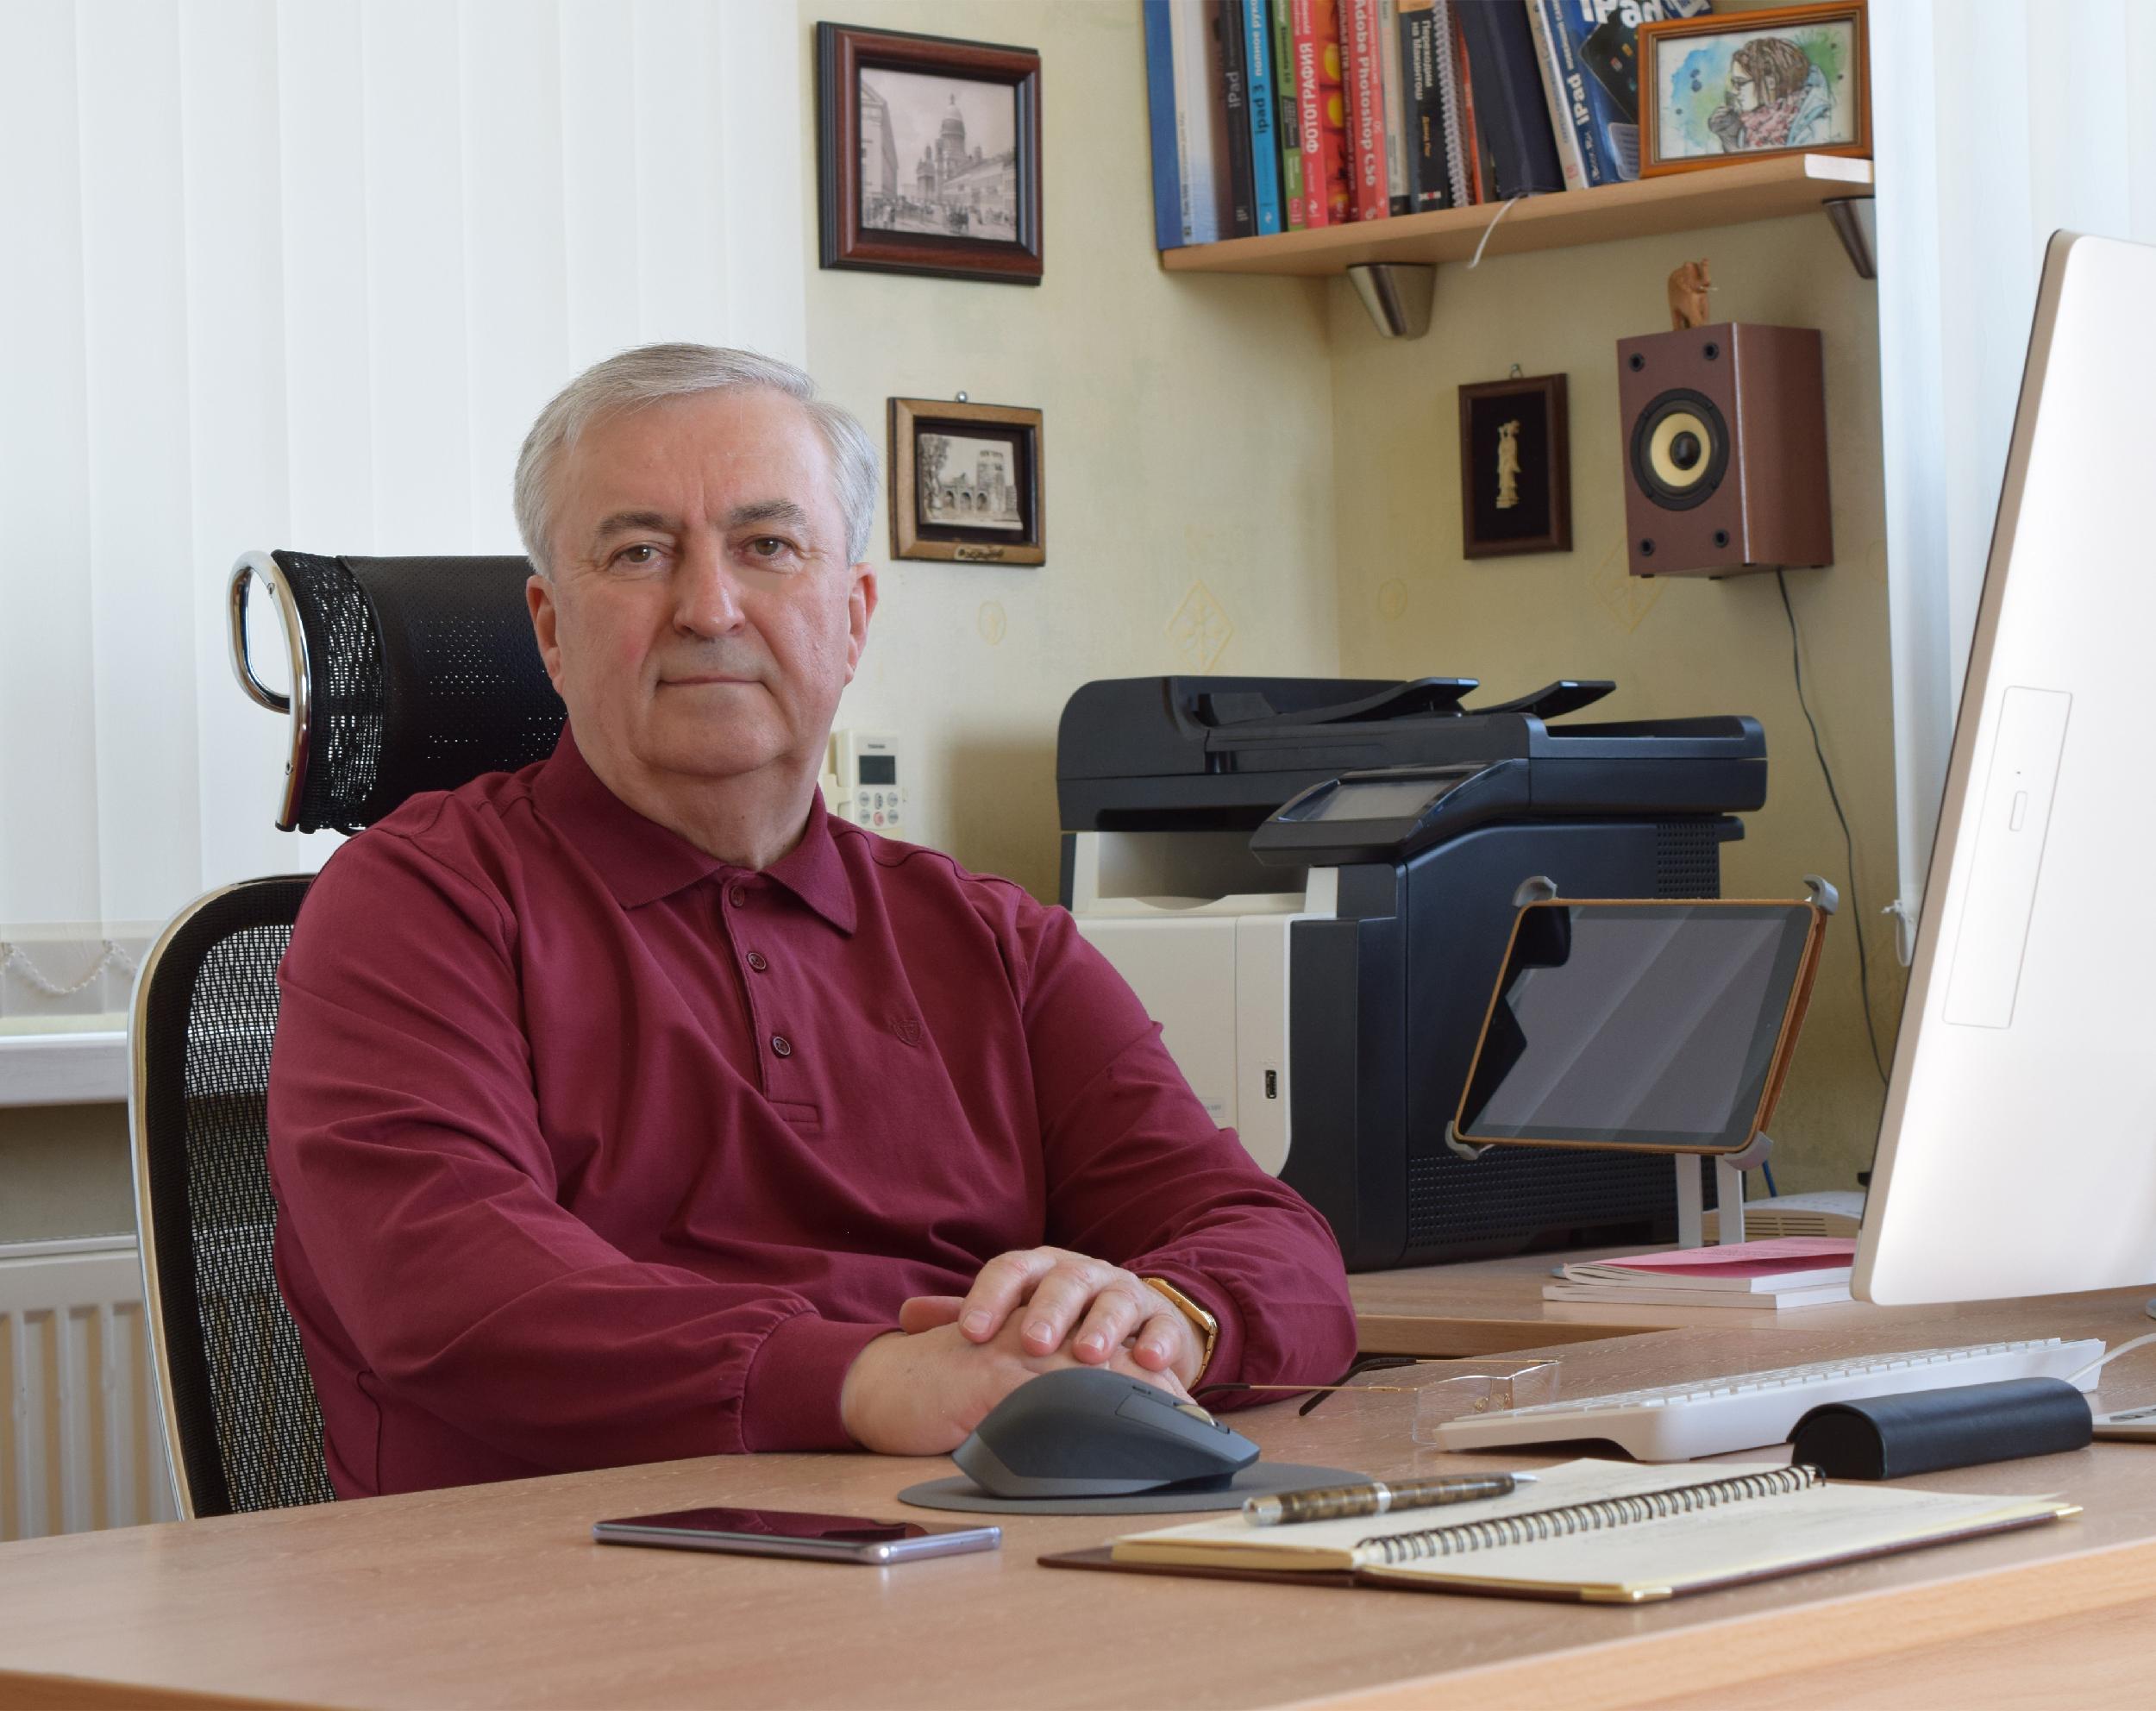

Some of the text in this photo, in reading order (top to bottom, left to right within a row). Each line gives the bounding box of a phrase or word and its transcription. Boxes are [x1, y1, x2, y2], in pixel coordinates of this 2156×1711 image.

[1355, 0, 1368, 53] Adobe
[1252, 30, 1263, 77] полное
[1412, 22, 1424, 100] на Макинтош
[1422, 21, 1432, 87] Переходим
[1225, 72, 1240, 108] iPad
[1253, 84, 1269, 134] ipad 3
[1300, 42, 1319, 154] ФОТОГРАФИЯ
[1357, 57, 1373, 150] Photoshop
[1567, 72, 1590, 125] iPad
[1363, 154, 1376, 186] CS6
